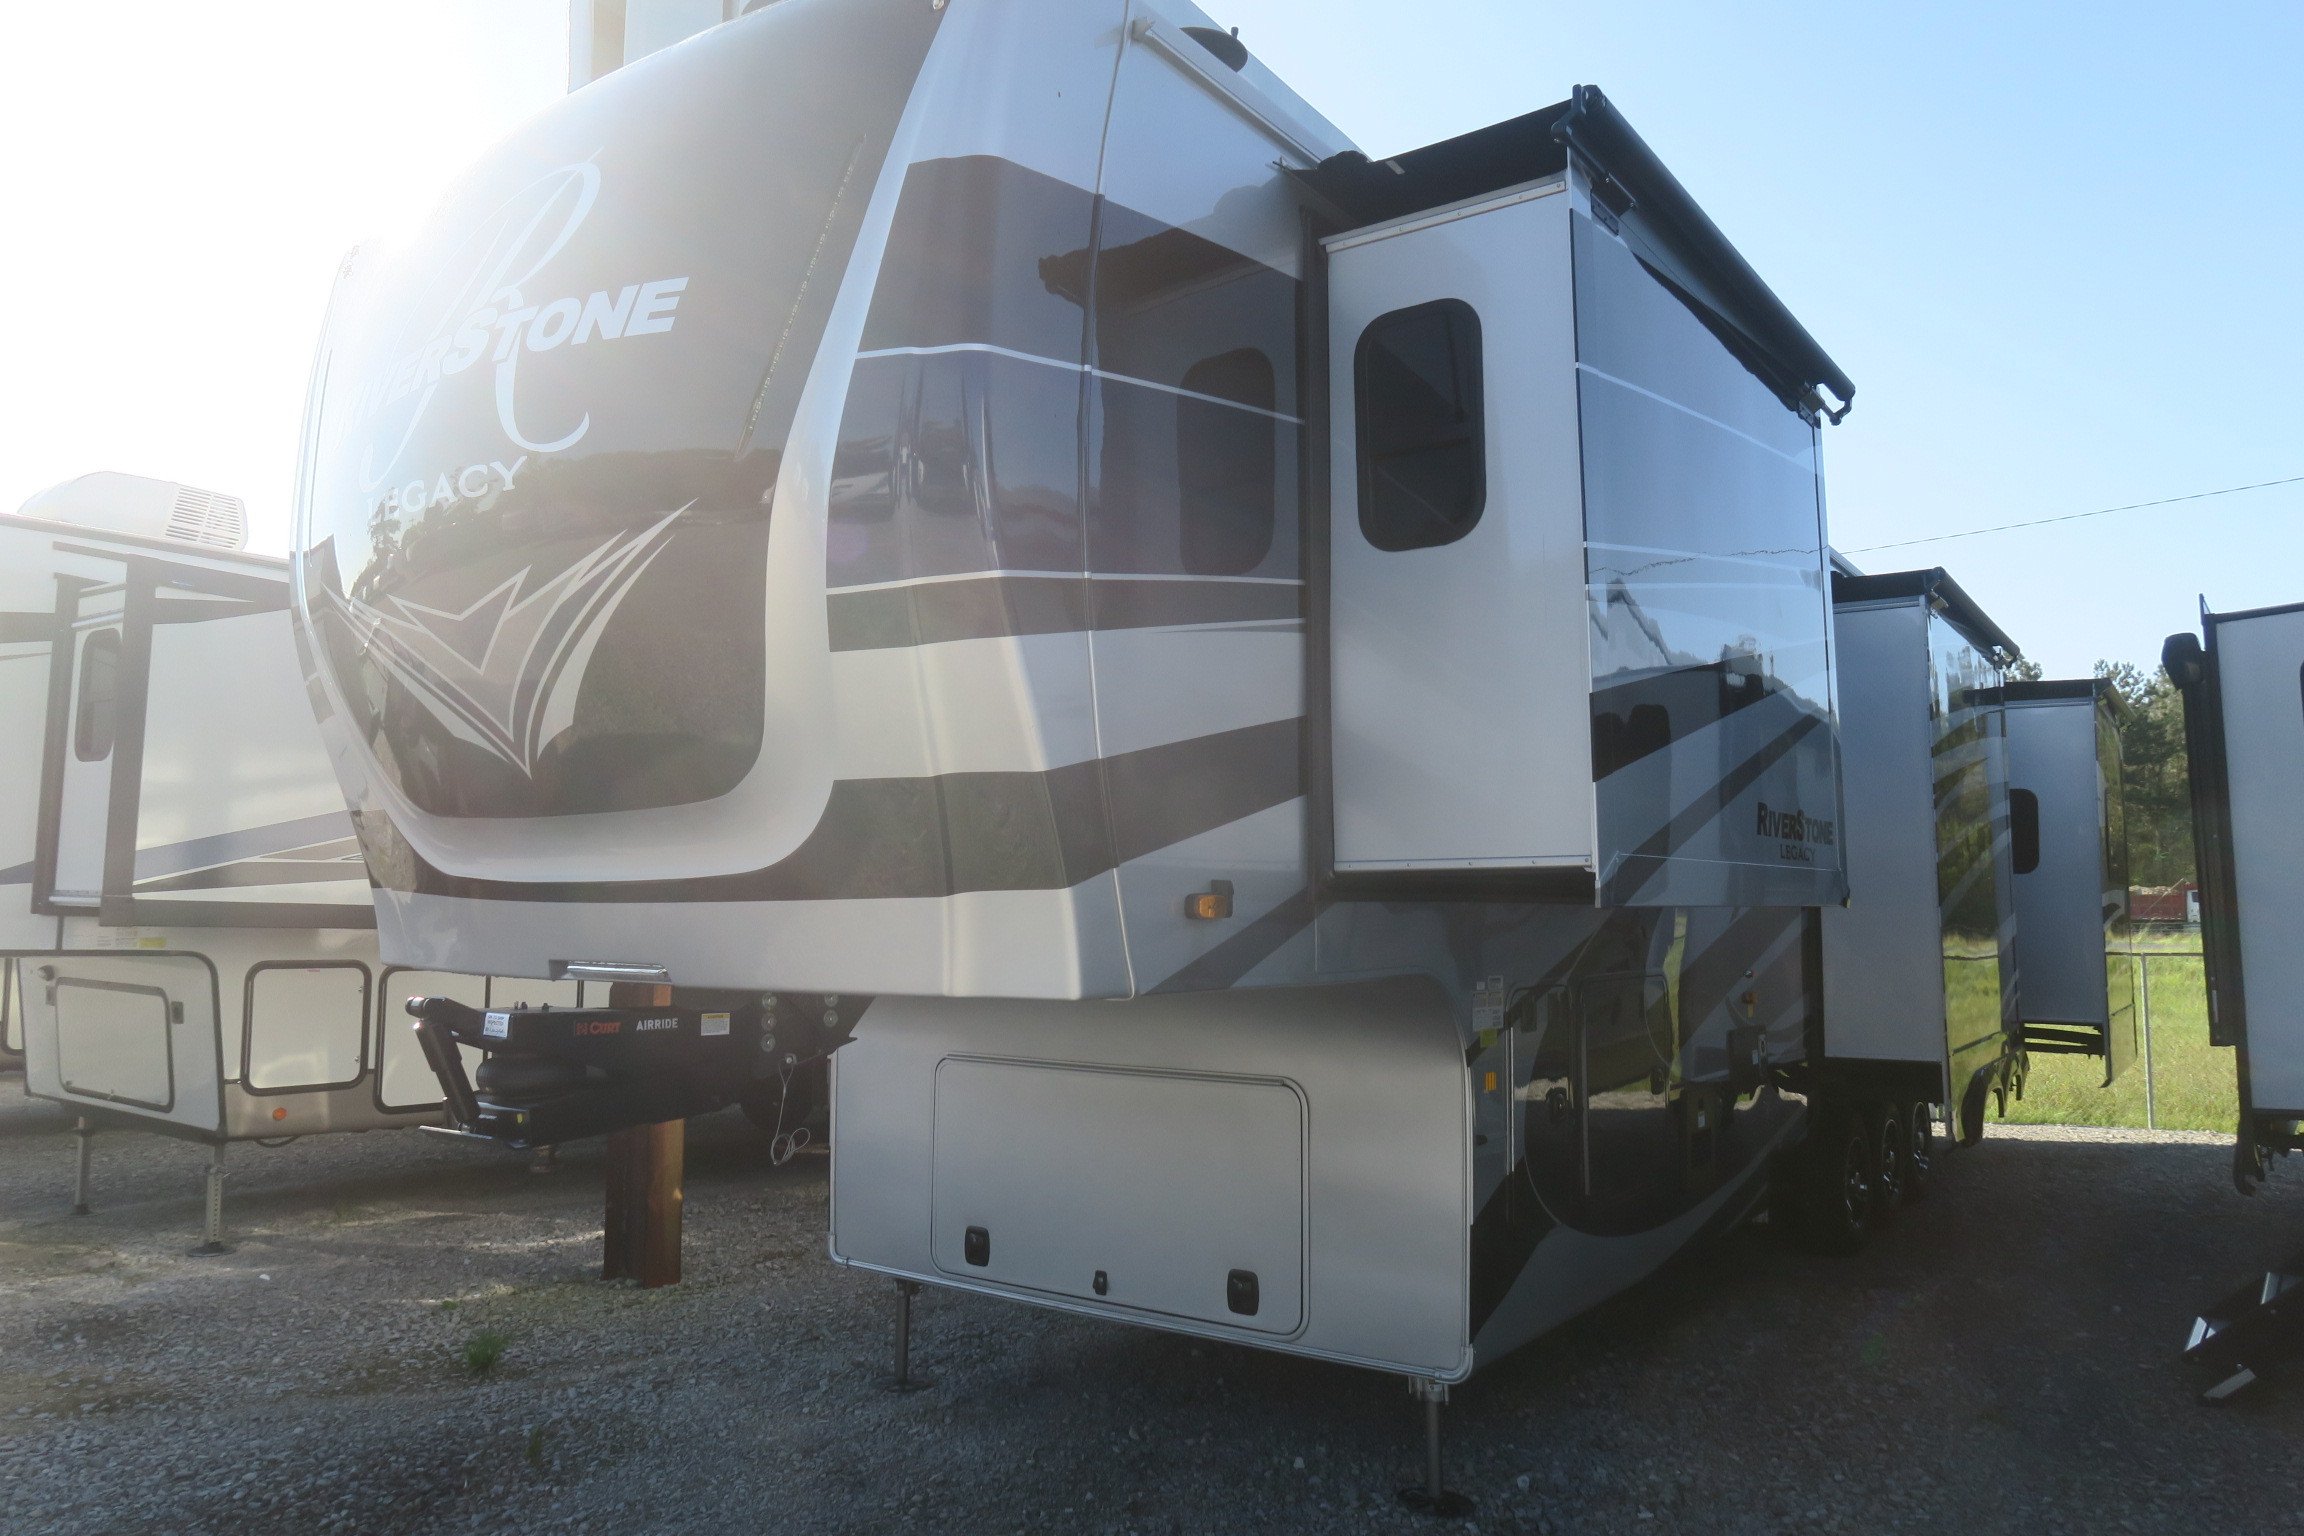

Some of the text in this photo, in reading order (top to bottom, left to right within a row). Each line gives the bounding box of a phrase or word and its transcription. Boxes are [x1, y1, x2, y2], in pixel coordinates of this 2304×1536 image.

[1757, 801, 1834, 846] RIVERSTONE
[1780, 844, 1815, 861] LEGACY
[590, 1018, 679, 1034] CURT AIRRIDE
